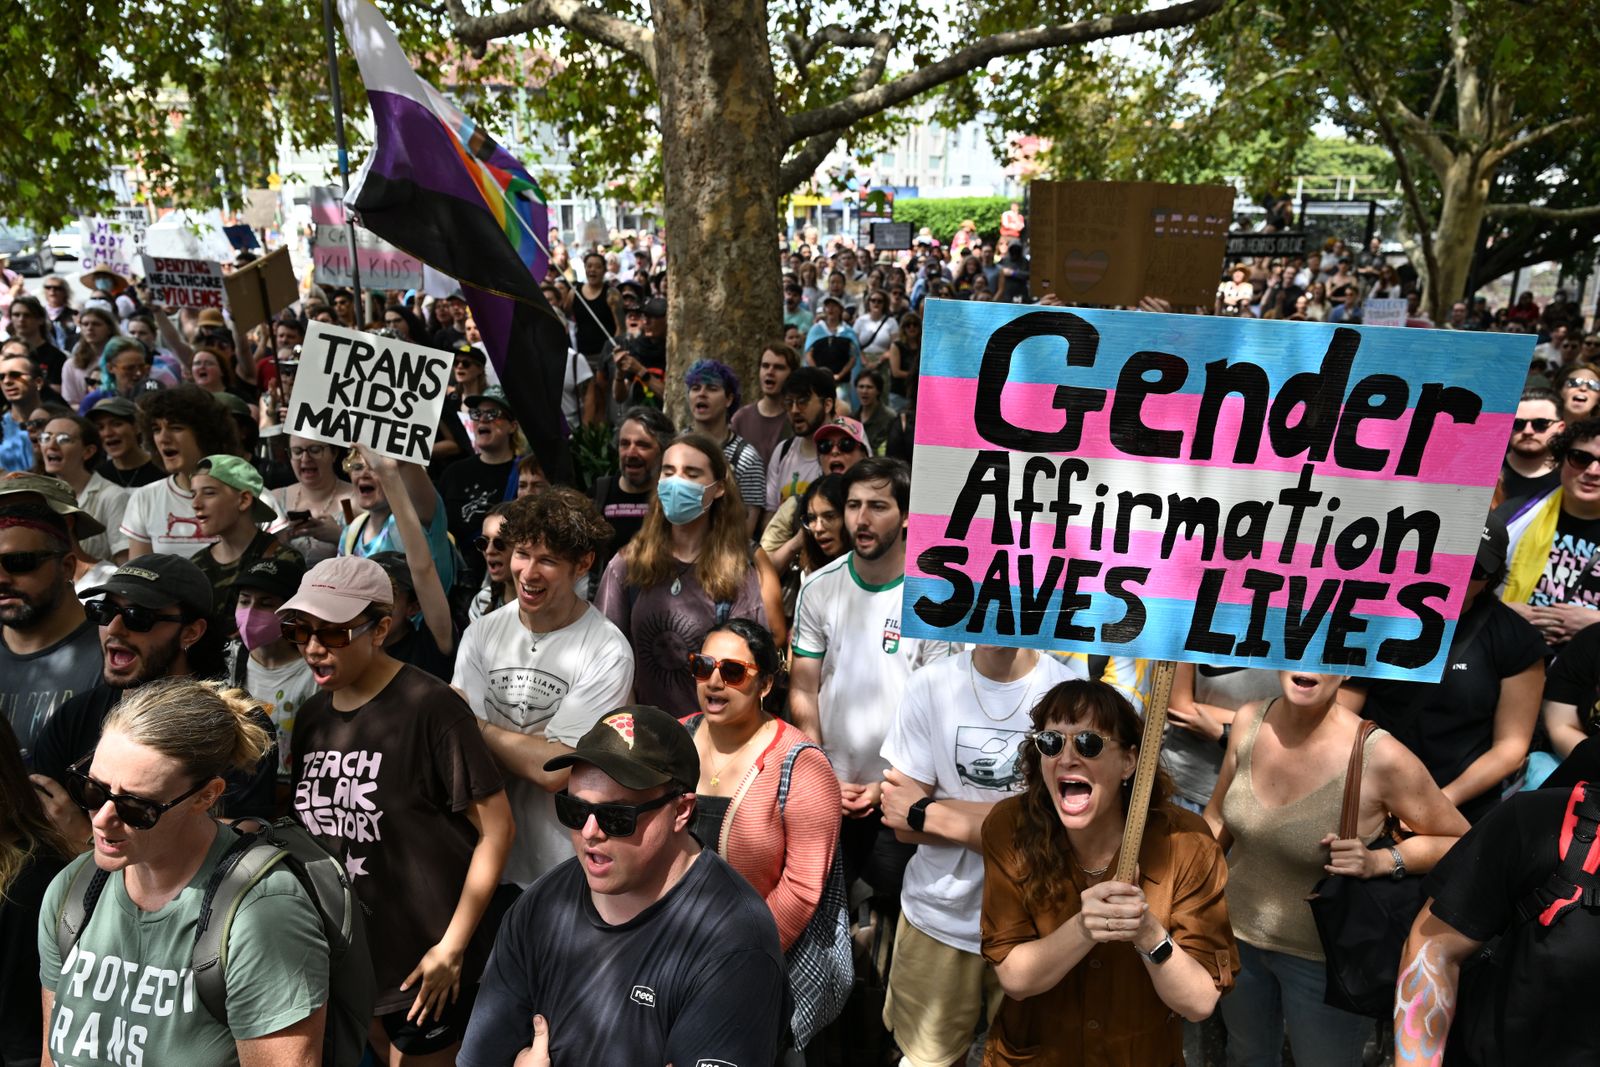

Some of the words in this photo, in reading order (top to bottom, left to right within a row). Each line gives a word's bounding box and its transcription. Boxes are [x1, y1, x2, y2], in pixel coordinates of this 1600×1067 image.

[89, 232, 124, 248] BODY
[94, 248, 116, 259] MY
[149, 272, 222, 288] HEALTHCARE
[153, 258, 211, 274] DENYING
[322, 255, 354, 278] KIL
[369, 257, 414, 280] KIDS
[151, 288, 164, 301] IS
[162, 287, 223, 308] VIOLENCE
[318, 332, 448, 400] TRANS
[327, 372, 419, 419] KIDS
[974, 311, 1482, 477] Gender
[294, 402, 432, 461] MATTER
[944, 450, 1440, 574] Affirmation
[913, 546, 1151, 643] SAVES
[1184, 569, 1452, 670] LIVES
[884, 619, 900, 630] FIL
[303, 750, 383, 780] TEACH
[294, 777, 378, 811] BLAK
[50, 1002, 148, 1067] RANS
